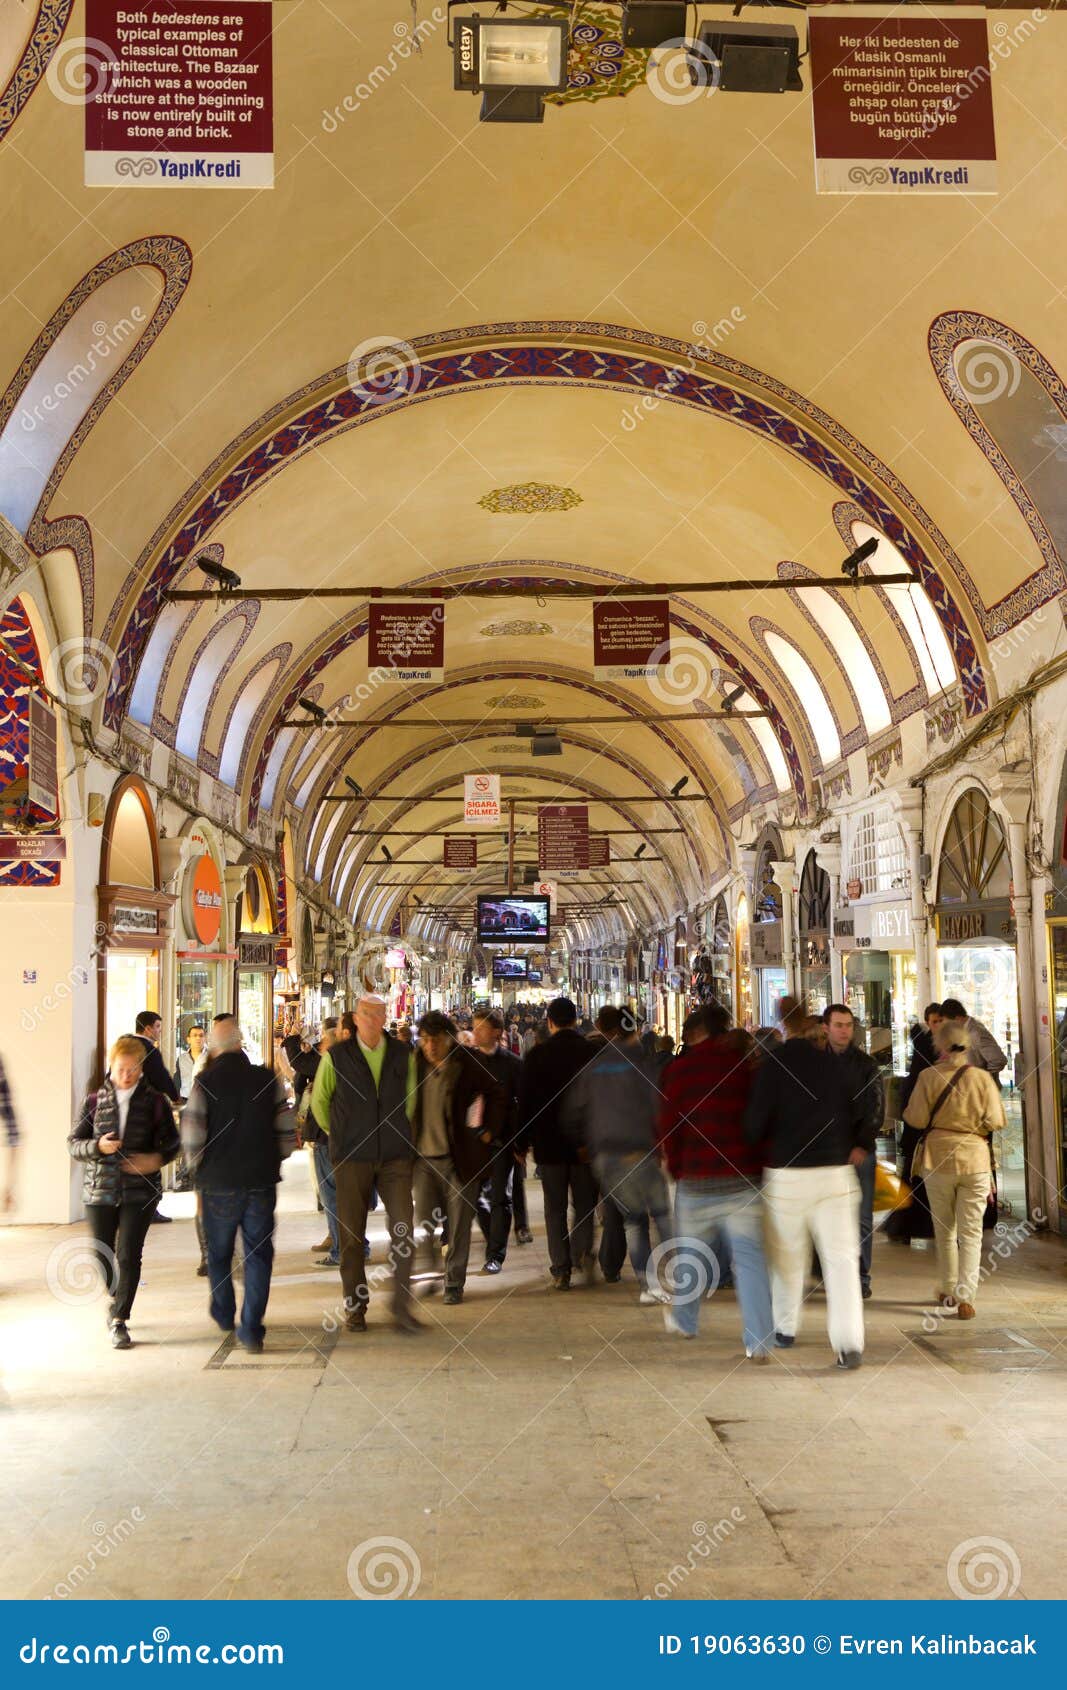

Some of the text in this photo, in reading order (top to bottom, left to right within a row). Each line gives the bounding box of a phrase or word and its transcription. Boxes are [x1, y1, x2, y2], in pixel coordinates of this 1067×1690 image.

[116, 11, 244, 25] Both bedestens are
[116, 28, 244, 43] typical examples of
[839, 36, 959, 49] Her iki bedesten de
[121, 44, 238, 58] classical Ottoman
[460, 26, 473, 71] detay
[854, 51, 946, 63] klasik Osmanlı
[100, 60, 259, 74] architecture. The Bazaar
[832, 65, 969, 80] mimarisinin tipik birer
[112, 76, 248, 90] which was a wooden
[843, 81, 960, 95] örneğidir. Önceleri
[95, 93, 264, 109] structure at the beginning
[849, 96, 888, 110] ahşap
[891, 96, 918, 108] olan
[107, 108, 252, 124] is now entirely built of
[850, 111, 957, 126] bugün bütünüyle
[127, 125, 232, 138] stone and brick.
[889, 167, 969, 187] YapıKredi
